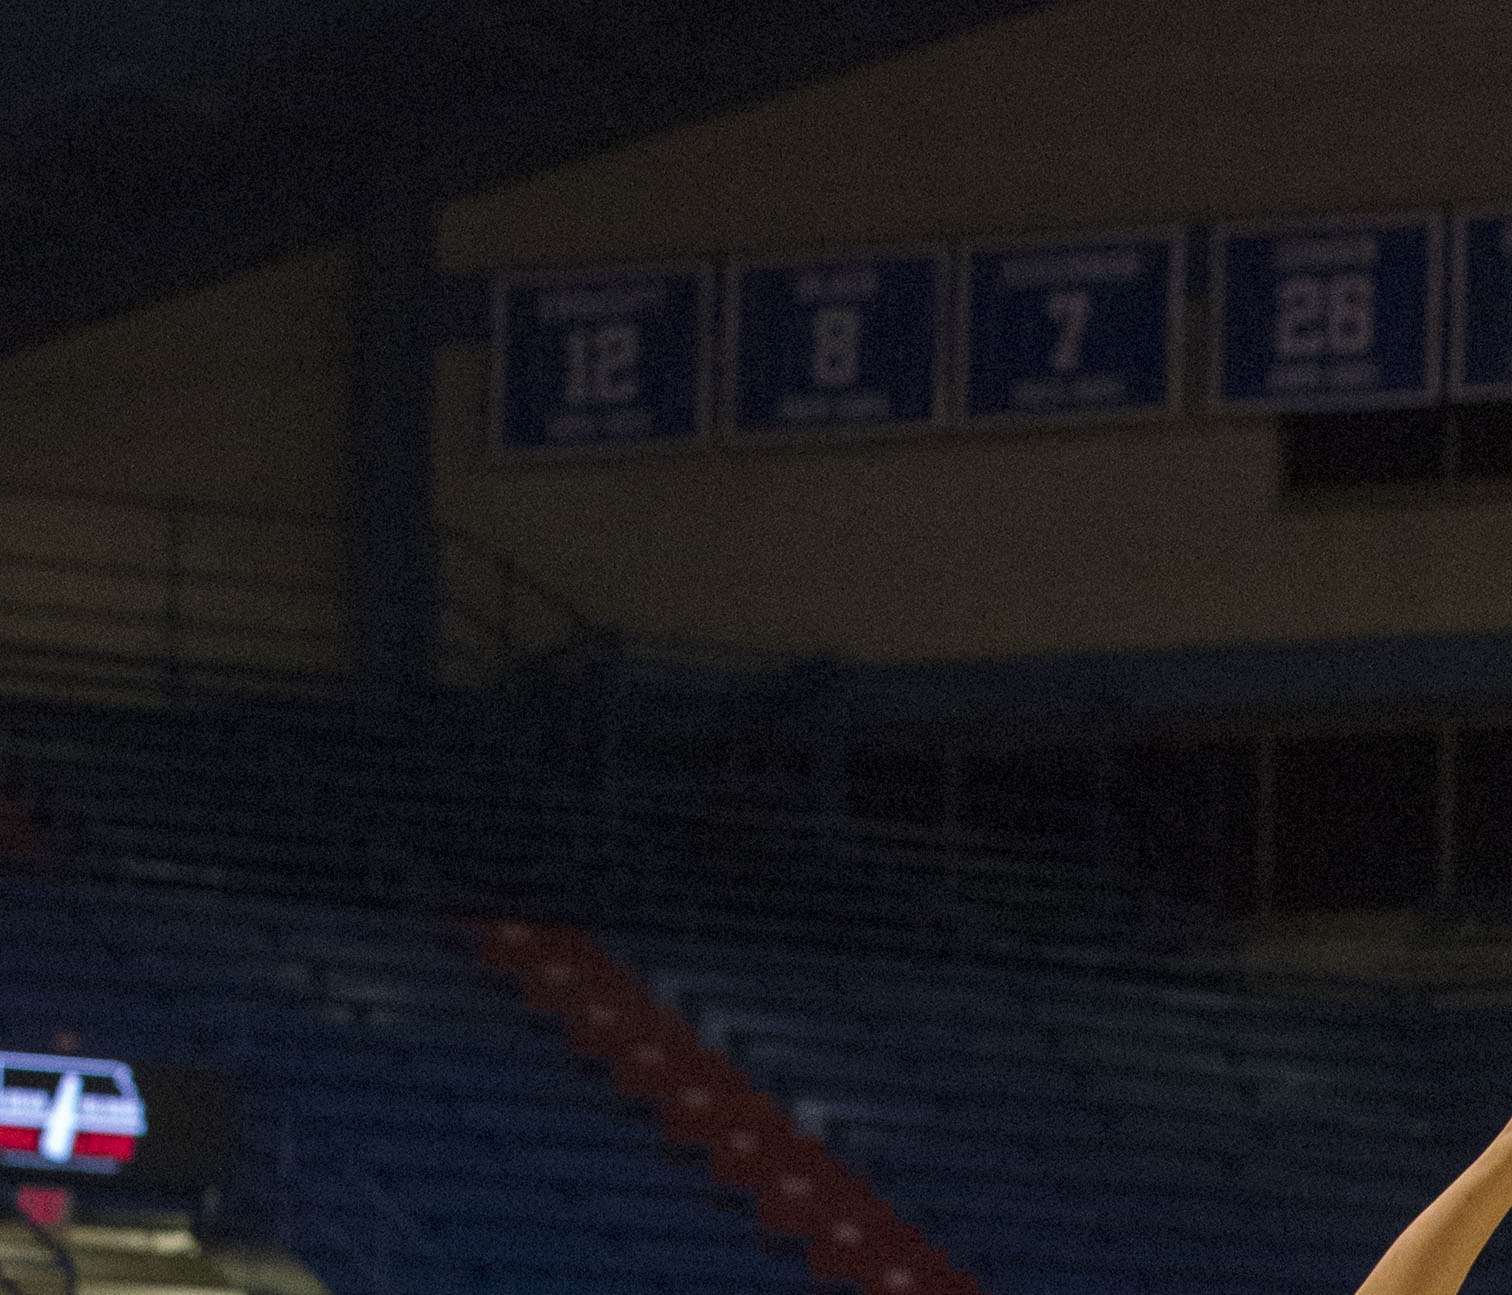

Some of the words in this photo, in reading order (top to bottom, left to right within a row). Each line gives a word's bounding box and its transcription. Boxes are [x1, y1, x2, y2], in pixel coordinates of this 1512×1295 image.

[566, 323, 639, 404] 12
[812, 307, 860, 387] 8
[1048, 291, 1091, 371] 7
